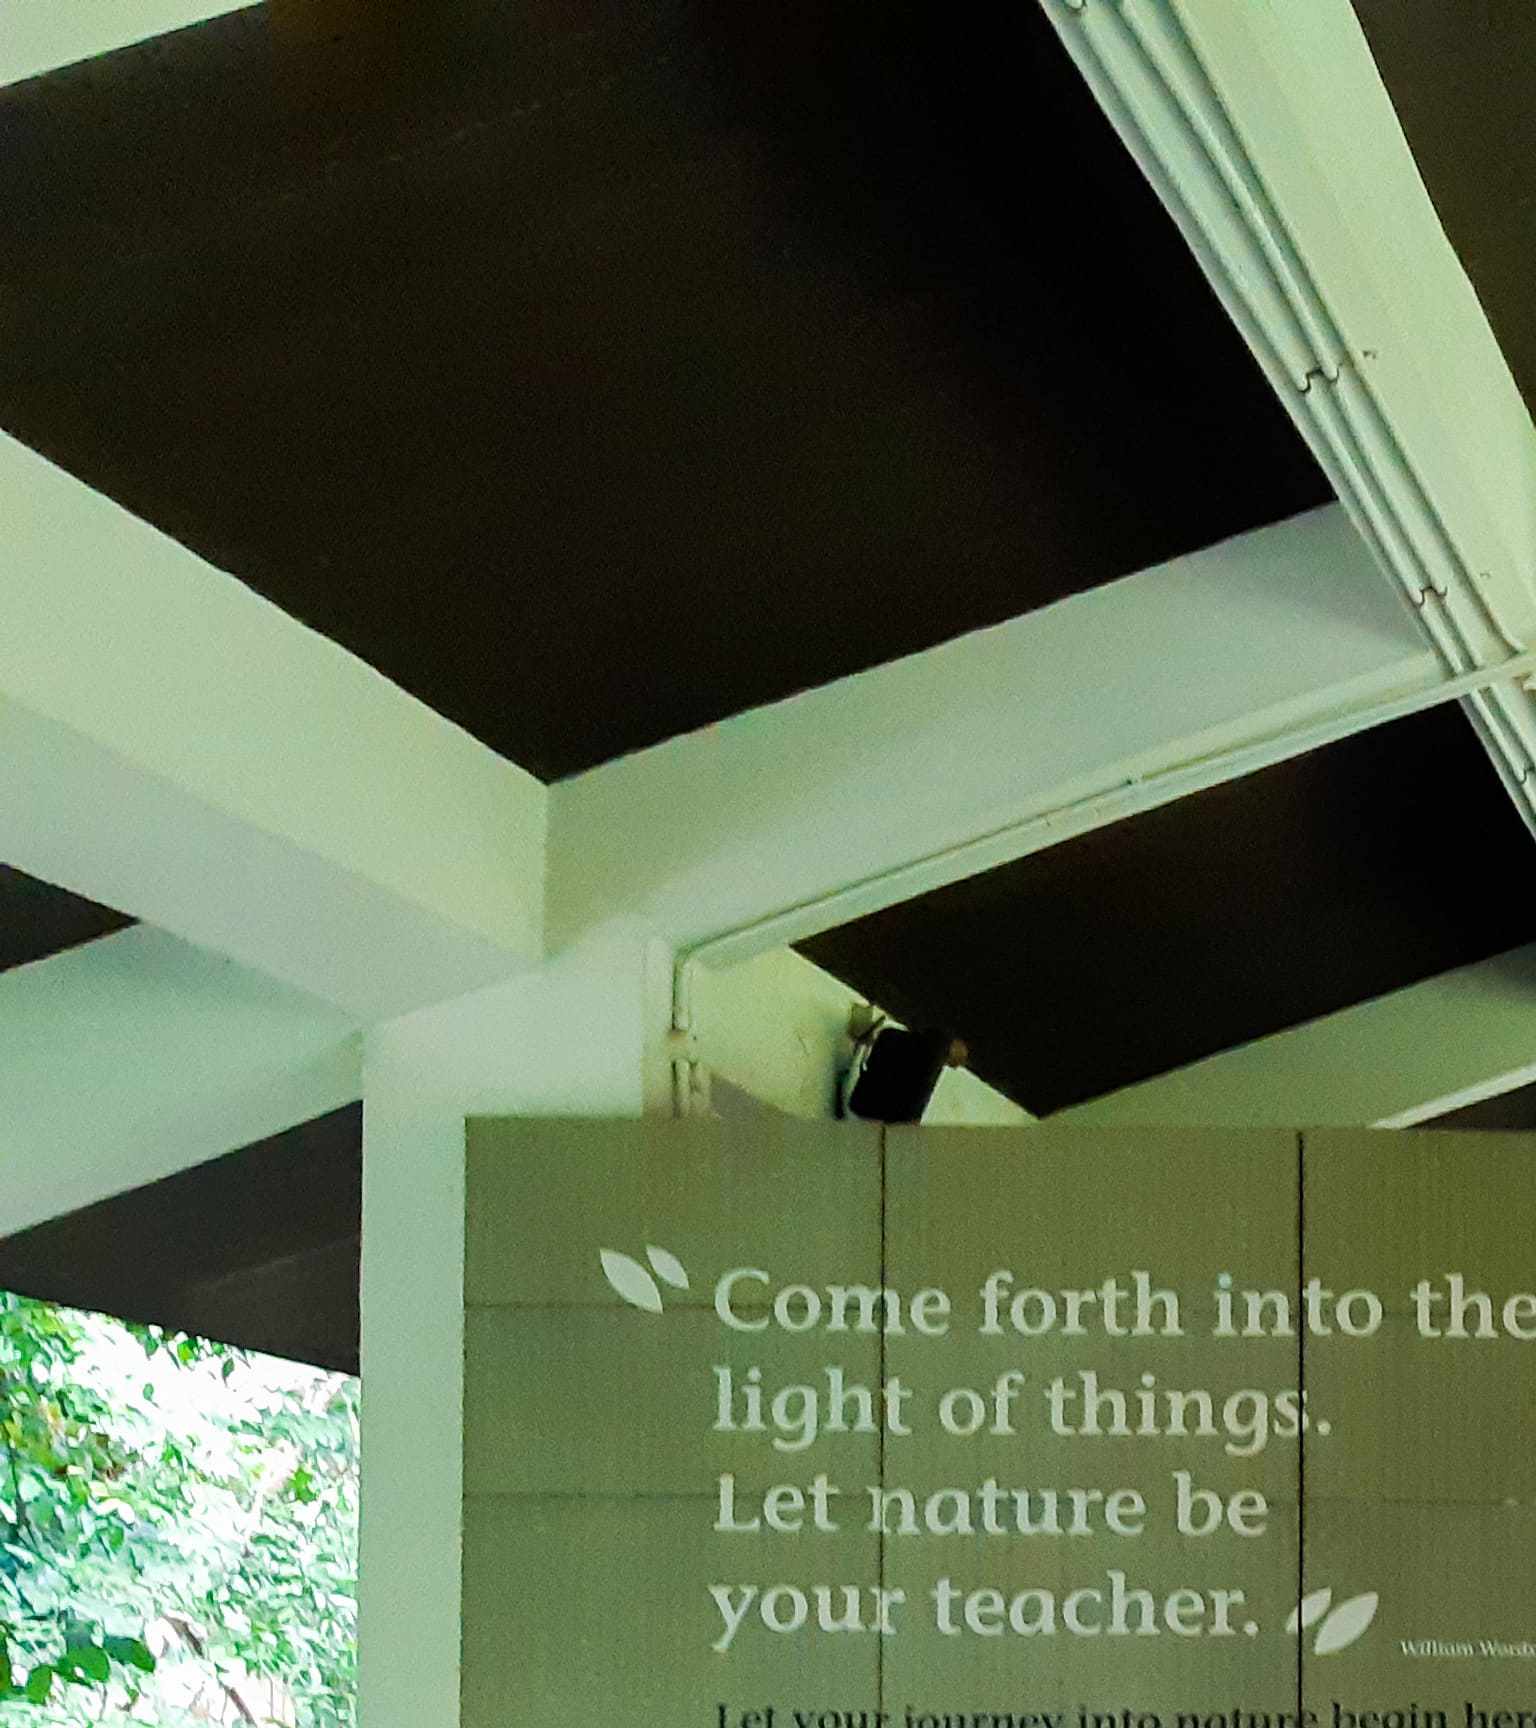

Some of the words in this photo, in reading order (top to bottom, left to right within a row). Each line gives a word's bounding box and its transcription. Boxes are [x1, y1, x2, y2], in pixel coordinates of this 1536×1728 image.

[713, 1267, 952, 1337] Come
[979, 1268, 1185, 1338] forth
[1212, 1271, 1384, 1337] into
[711, 1365, 914, 1452] light
[937, 1368, 1026, 1436] of
[1043, 1370, 1333, 1458] things.
[712, 1471, 841, 1533] Let
[863, 1476, 1147, 1538] nature
[1172, 1468, 1270, 1539] be
[706, 1582, 908, 1654] your
[930, 1568, 1261, 1638] teacher.
[1400, 1640, 1474, 1658] William
